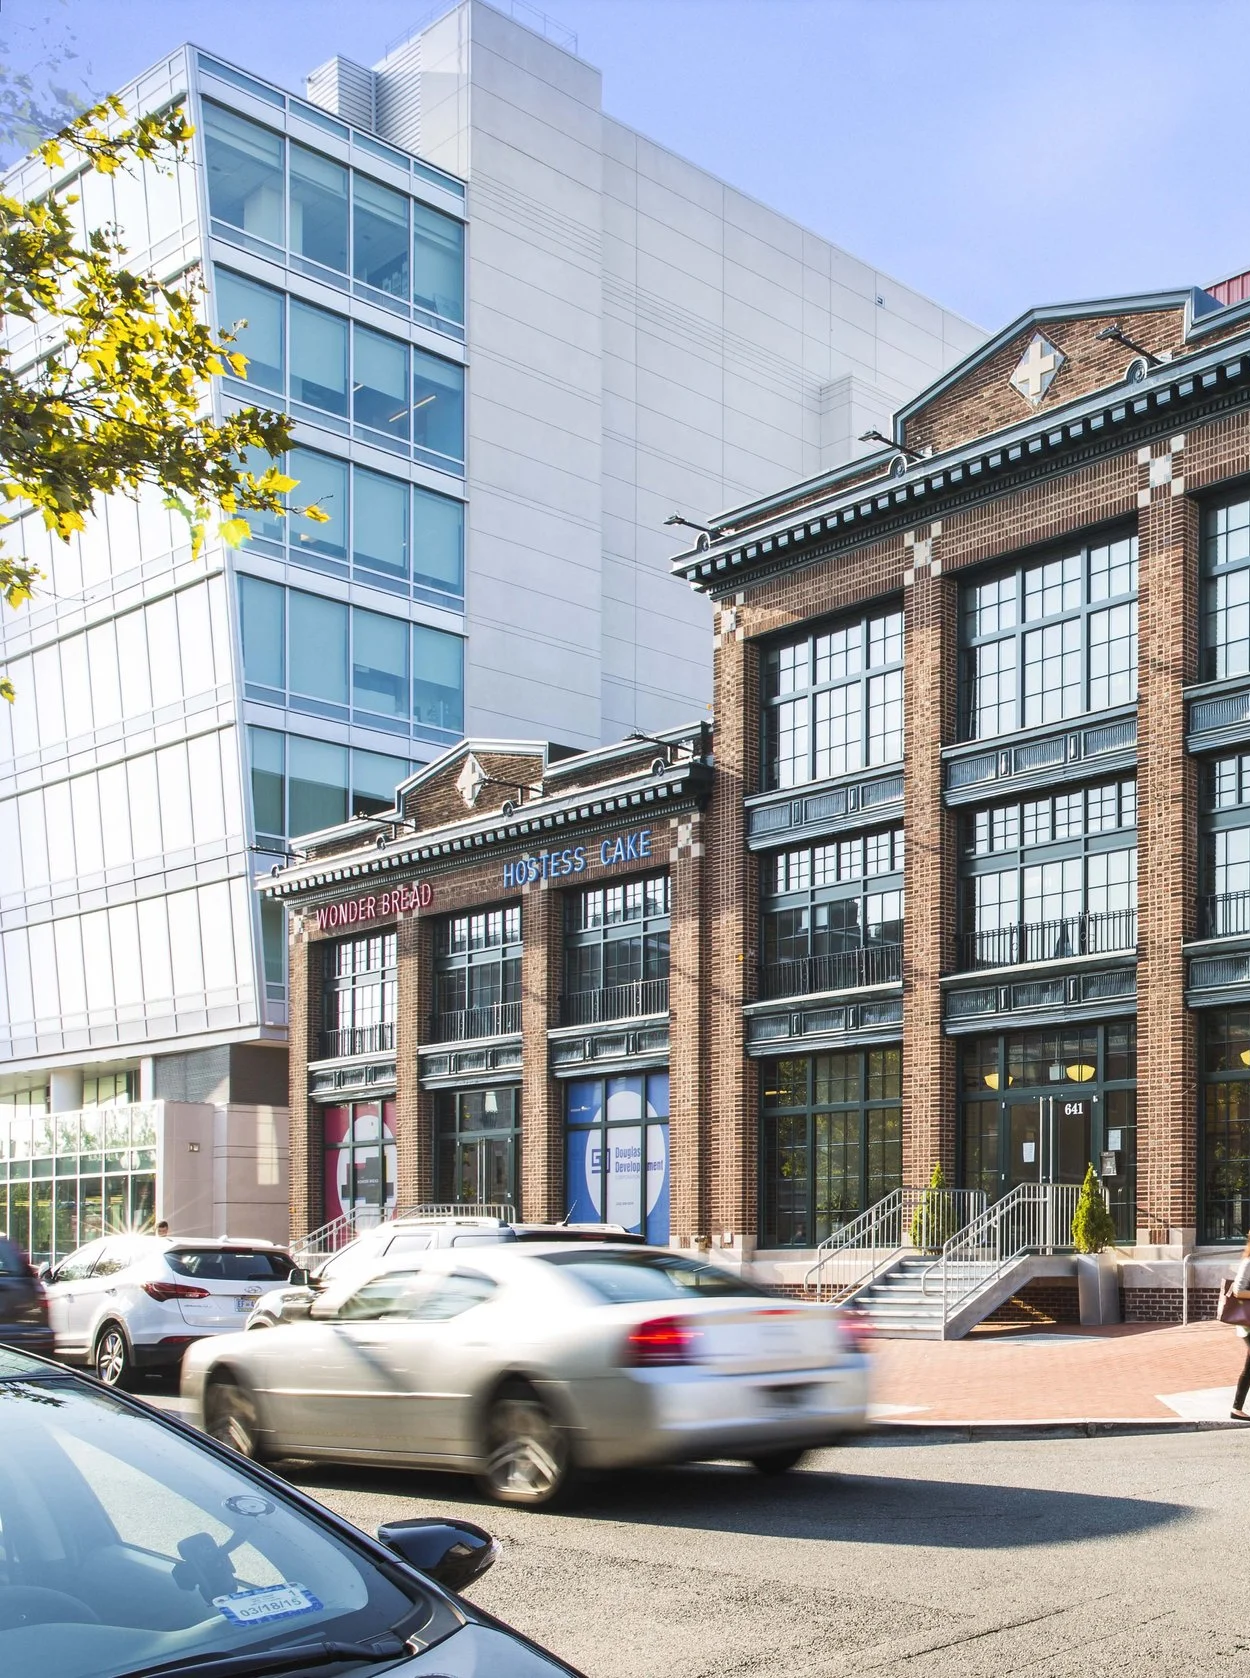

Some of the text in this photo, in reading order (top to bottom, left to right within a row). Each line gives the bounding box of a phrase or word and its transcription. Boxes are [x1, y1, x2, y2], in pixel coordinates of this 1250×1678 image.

[503, 830, 652, 888] HOSTESS CAKE
[316, 883, 433, 930] WONDER BREAD
[1064, 1102, 1084, 1116] 641
[615, 1146, 641, 1159] Douglas
[239, 1598, 303, 1617] 03/18/15
